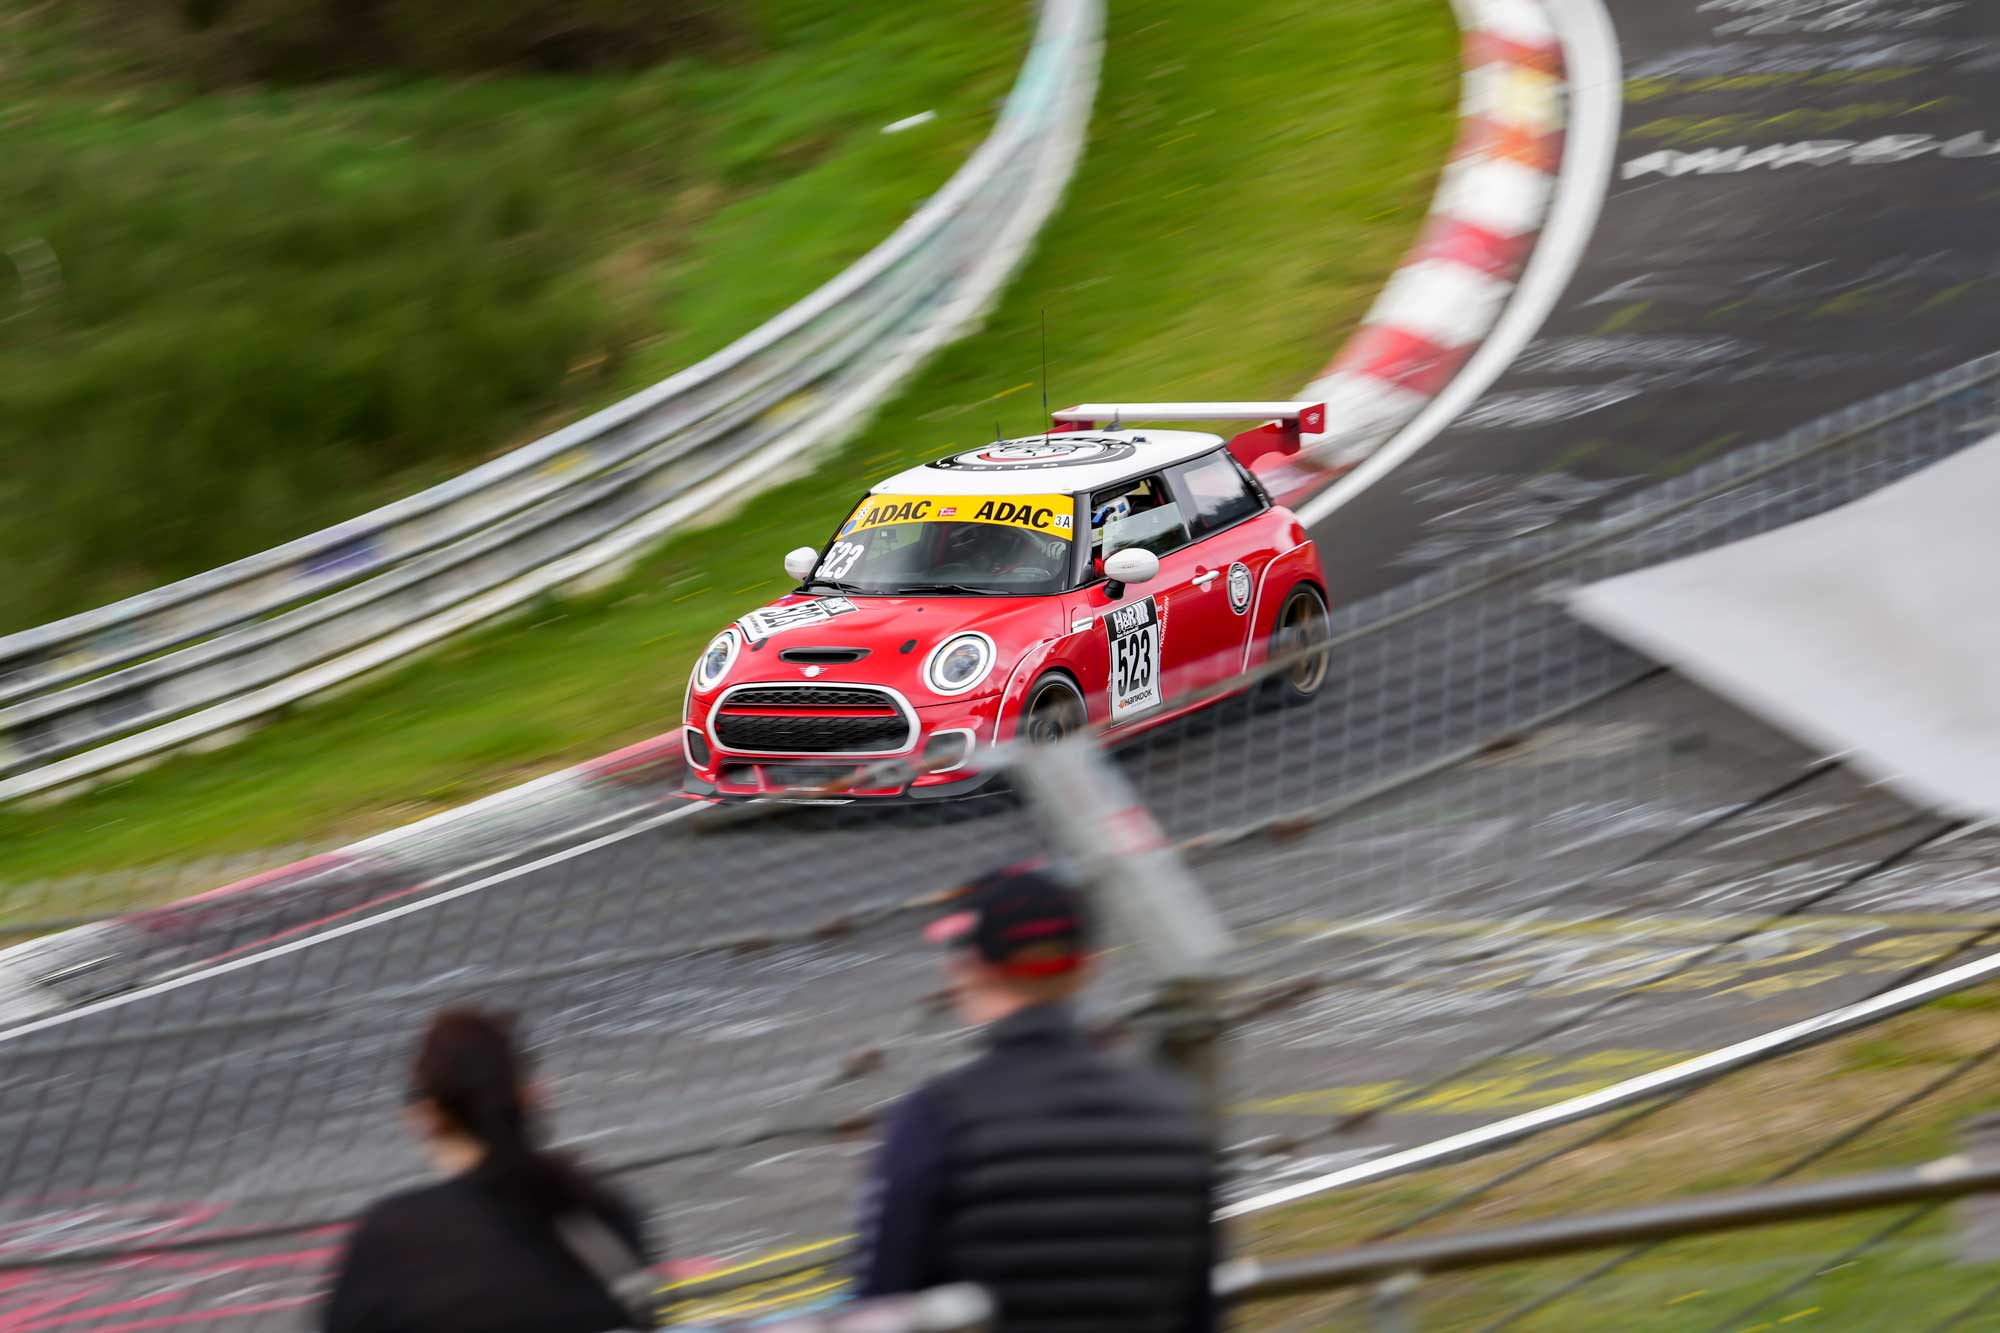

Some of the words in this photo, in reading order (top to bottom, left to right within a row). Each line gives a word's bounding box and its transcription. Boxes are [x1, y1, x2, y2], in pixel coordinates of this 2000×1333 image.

[862, 501, 931, 527] ADAC
[974, 501, 1053, 529] ADAC
[814, 541, 864, 579] 523
[760, 603, 824, 628] 523
[1117, 629, 1151, 697] 523
